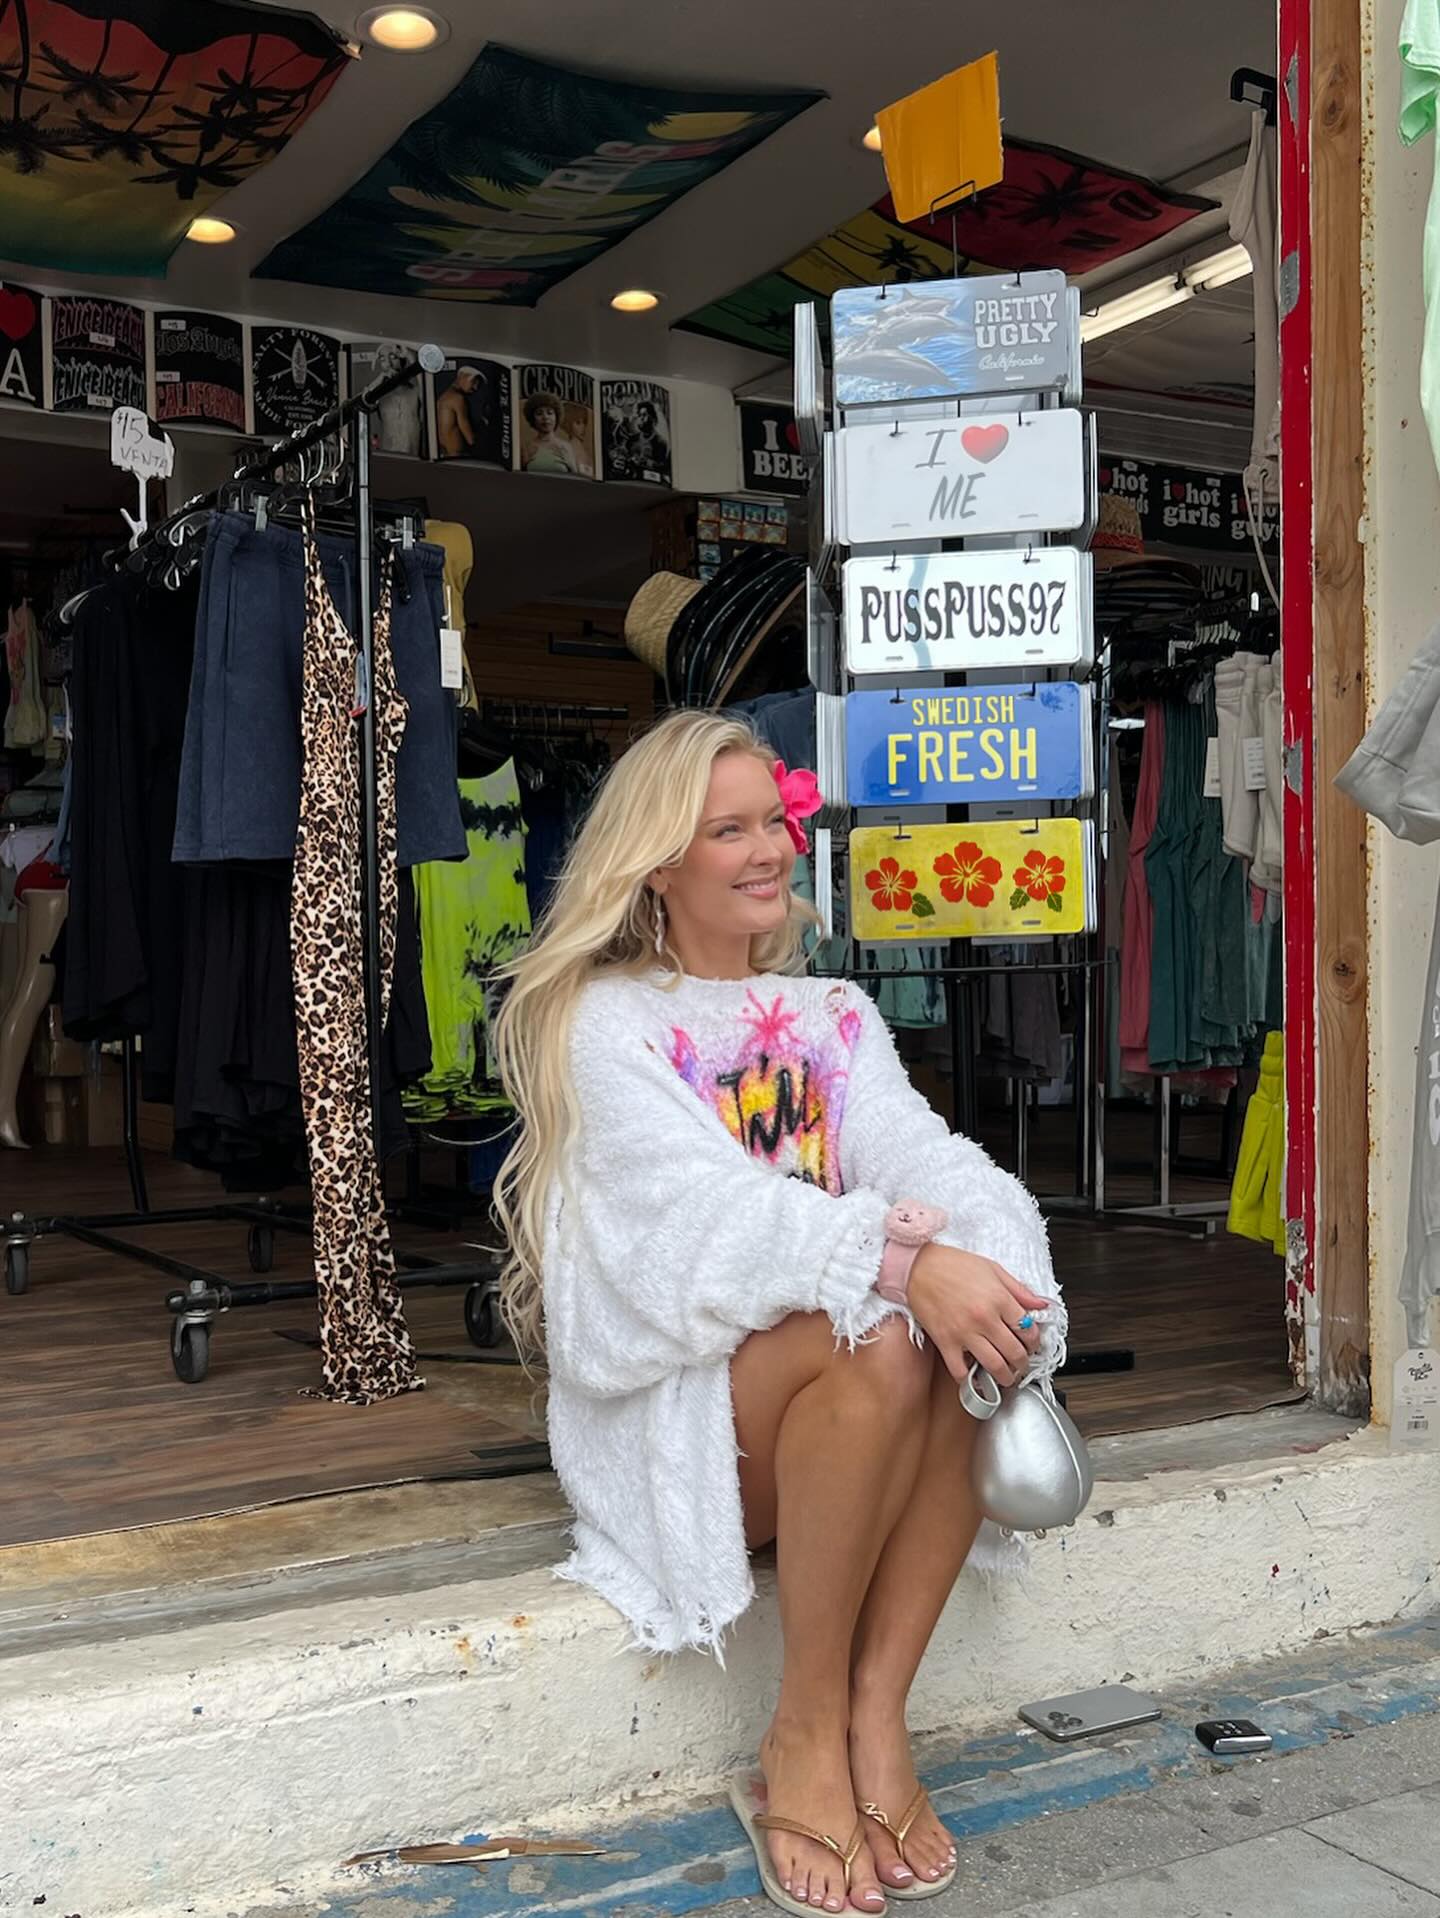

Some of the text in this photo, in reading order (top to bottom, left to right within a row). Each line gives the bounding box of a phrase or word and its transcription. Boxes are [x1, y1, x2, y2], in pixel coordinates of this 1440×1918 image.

[974, 292, 1057, 324] PRETTY
[975, 321, 1058, 348] UGLY
[54, 356, 102, 404] ENICE
[117, 411, 144, 444] $15
[762, 420, 779, 451] I
[915, 429, 957, 468] I
[1112, 467, 1149, 493] hot
[1185, 482, 1221, 507] hot
[929, 472, 986, 521] ME
[1163, 503, 1221, 528] girls
[860, 581, 1067, 643] PUSSPUSS97
[912, 695, 1015, 727] SWEDISH
[887, 727, 1037, 785] FRESH
